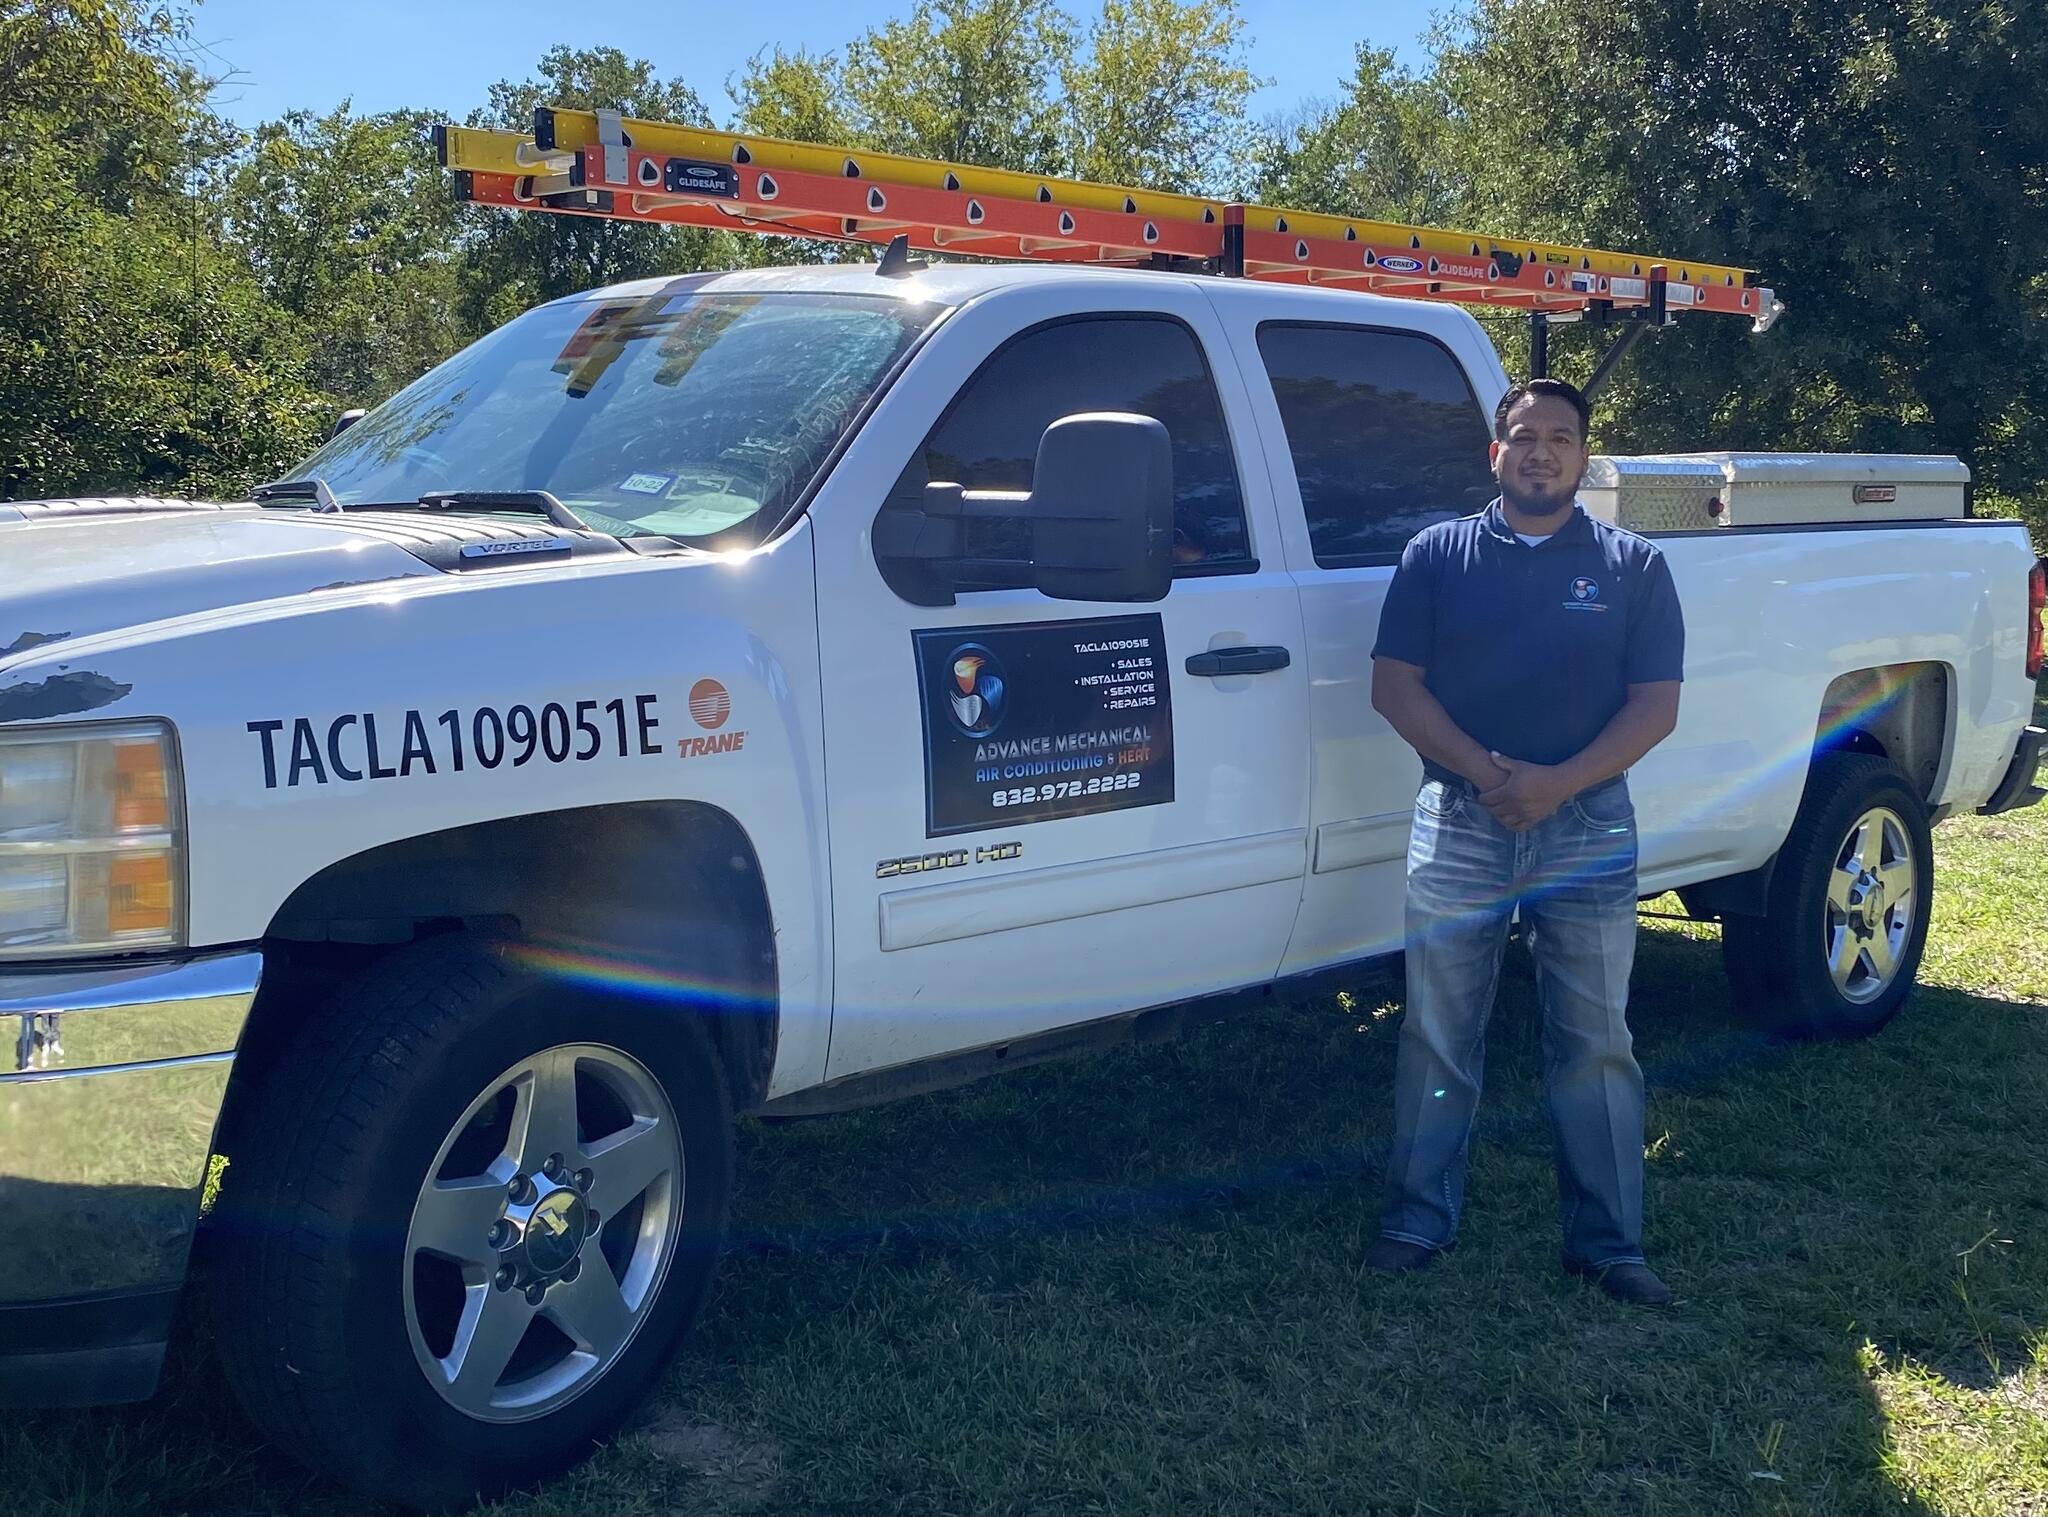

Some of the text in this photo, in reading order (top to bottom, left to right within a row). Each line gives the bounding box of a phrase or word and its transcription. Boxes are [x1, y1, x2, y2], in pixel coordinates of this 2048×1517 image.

[679, 177, 726, 189] GLIDESAFE
[1386, 259, 1415, 268] WERNER
[1439, 264, 1484, 278] GLIDESAFE
[478, 540, 553, 553] VORTEC
[1074, 638, 1150, 653] TACLA109051E
[1117, 657, 1153, 669] SALES
[1080, 670, 1154, 686] INSTALLATION
[1109, 683, 1155, 696] SERVICE
[1109, 696, 1157, 710] REPAIRS
[246, 694, 662, 788] TACLA109051E
[678, 731, 745, 758] TRANE
[974, 725, 1152, 763] ADVANCE MECHANICAL
[975, 747, 1151, 783] AIR CONDITIONING & HEAT
[992, 772, 1141, 808] 832.972.2222
[876, 841, 1023, 879] 2500 HD
